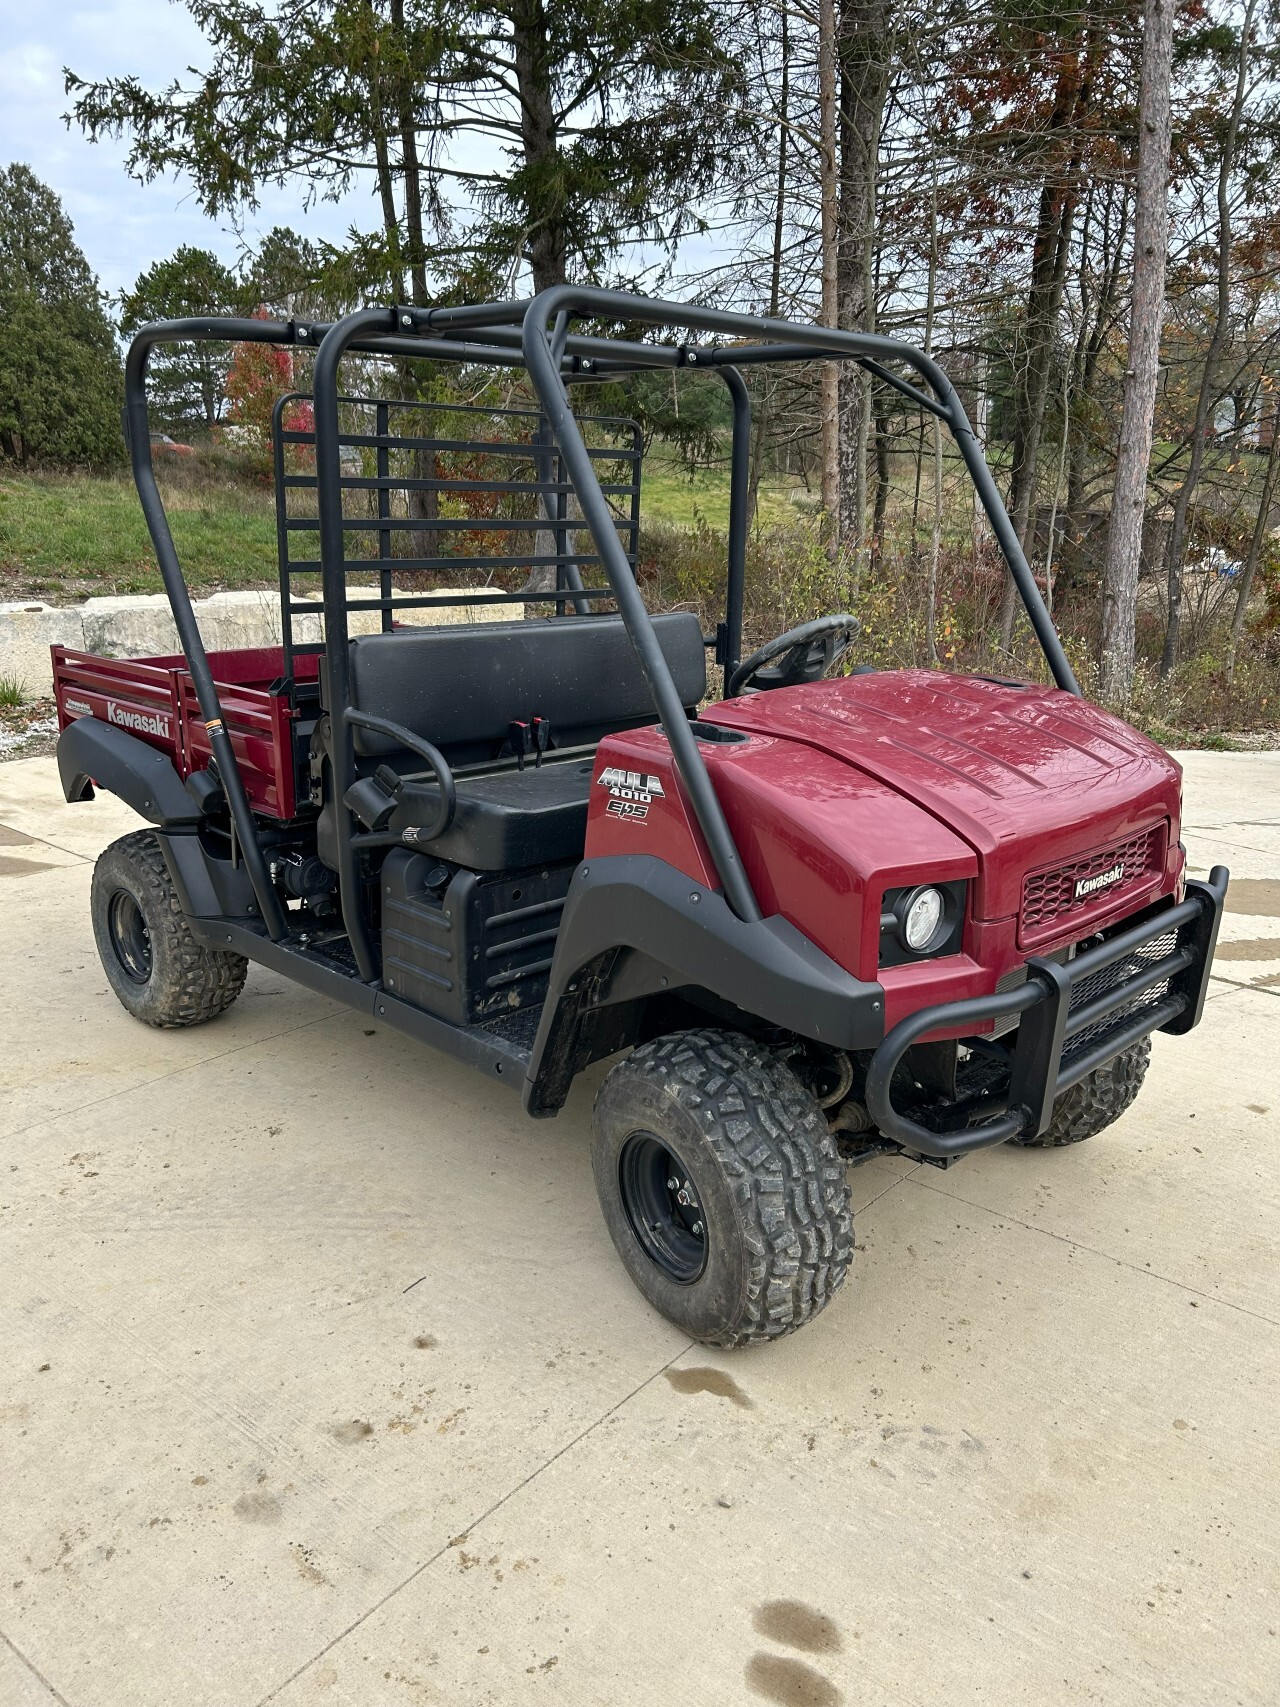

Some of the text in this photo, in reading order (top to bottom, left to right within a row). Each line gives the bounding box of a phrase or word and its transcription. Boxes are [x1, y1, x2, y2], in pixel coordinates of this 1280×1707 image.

[107, 701, 169, 738] Kawasaki
[597, 767, 666, 798] MULE
[609, 787, 652, 803] 4010
[1075, 863, 1125, 898] Kawasaki
